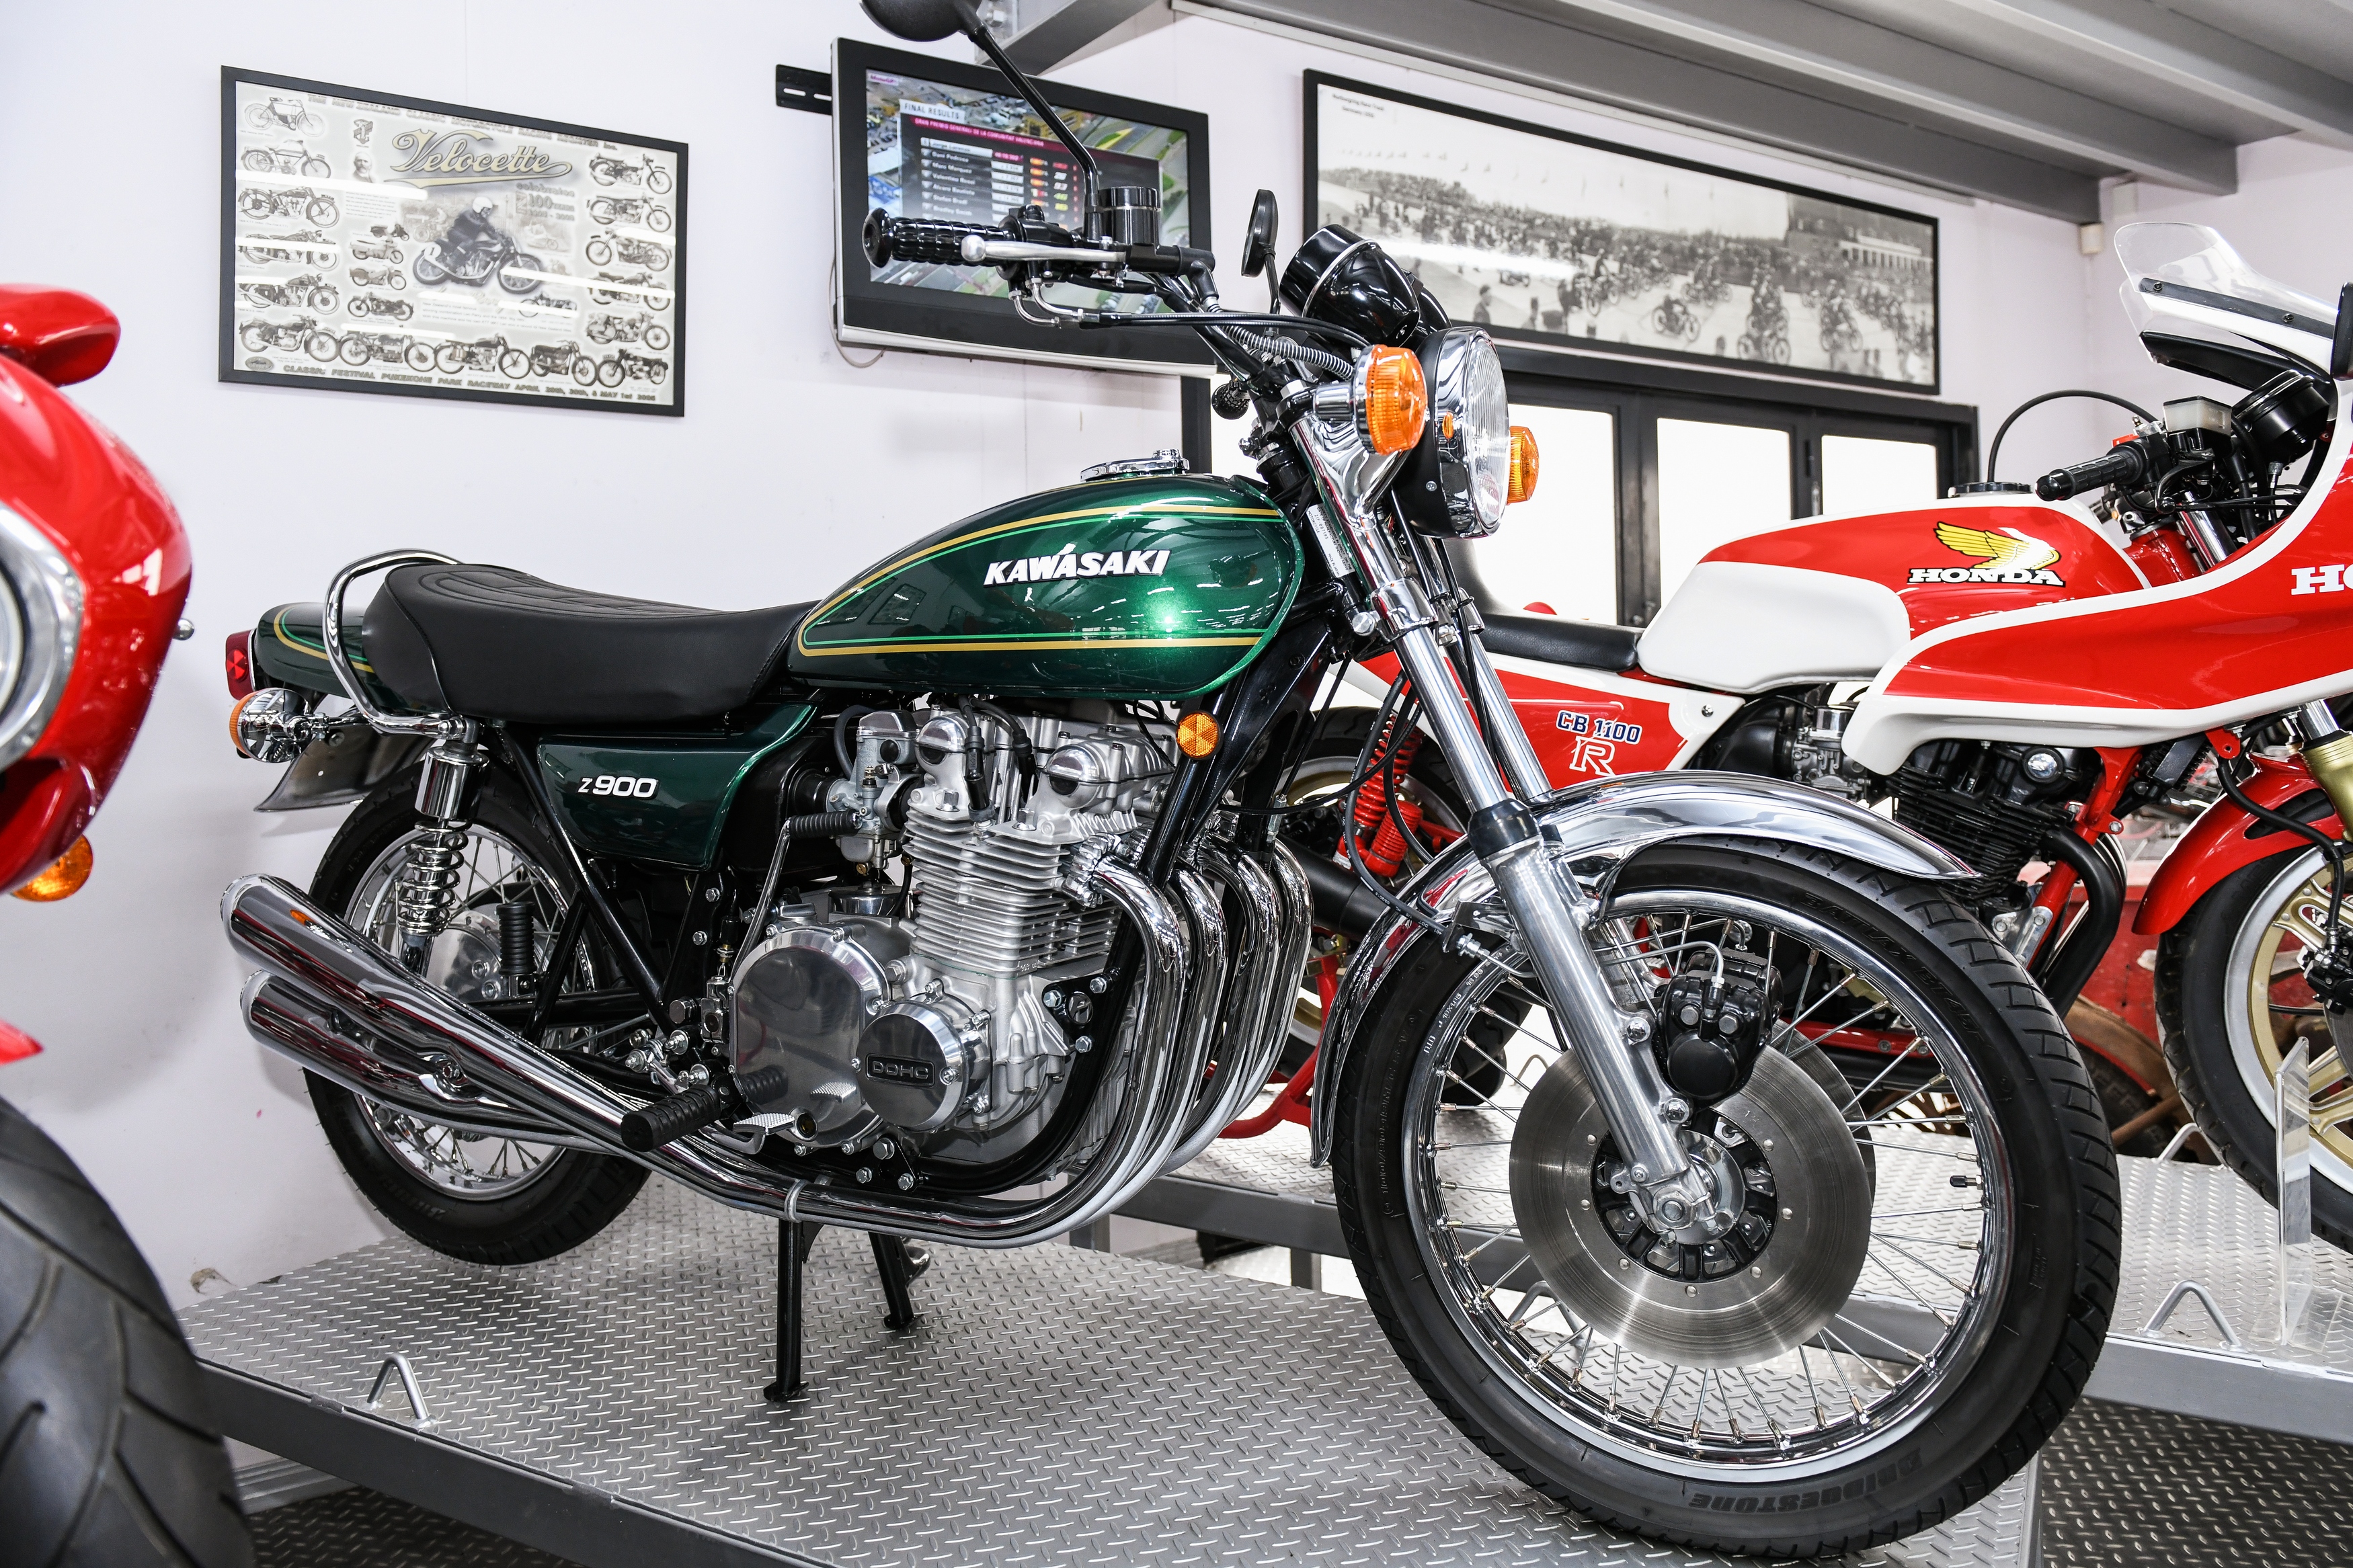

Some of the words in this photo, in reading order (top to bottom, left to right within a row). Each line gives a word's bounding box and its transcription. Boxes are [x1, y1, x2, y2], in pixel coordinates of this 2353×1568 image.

[307, 94, 327, 104] THE
[331, 98, 354, 108] NEW
[356, 102, 401, 116] ZEALAND
[406, 110, 446, 124] CLASSIC
[451, 117, 514, 134] MOTORCYCLE
[905, 103, 925, 113] FINAL
[928, 108, 959, 120] RESULTS
[390, 128, 573, 175] Velocette
[528, 194, 553, 209] 100
[283, 364, 326, 375] CLASSIC
[331, 368, 375, 379] FESTIVAL
[381, 373, 432, 383] PUKEKOHE
[438, 376, 462, 386] PARK
[467, 380, 510, 390] RACEWAY
[514, 384, 540, 392] APRIL
[1307, 509, 1320, 533] MOTORCYCLE
[1320, 505, 1328, 519] SAFETY
[1326, 518, 1337, 539] STANDARDS
[1324, 521, 1337, 546] MANUFACTURE
[1334, 546, 1343, 559] SHOWN
[983, 549, 1171, 587] KAWASAKI
[1907, 567, 2065, 587] HONDA
[1556, 709, 1589, 735] CB
[1593, 718, 1642, 745] 1100
[1569, 735, 1616, 776] R
[1419, 920, 1429, 928] DOT
[872, 1061, 929, 1079] DOHC
[1689, 1448, 1922, 1513] BRIDGESTONE
